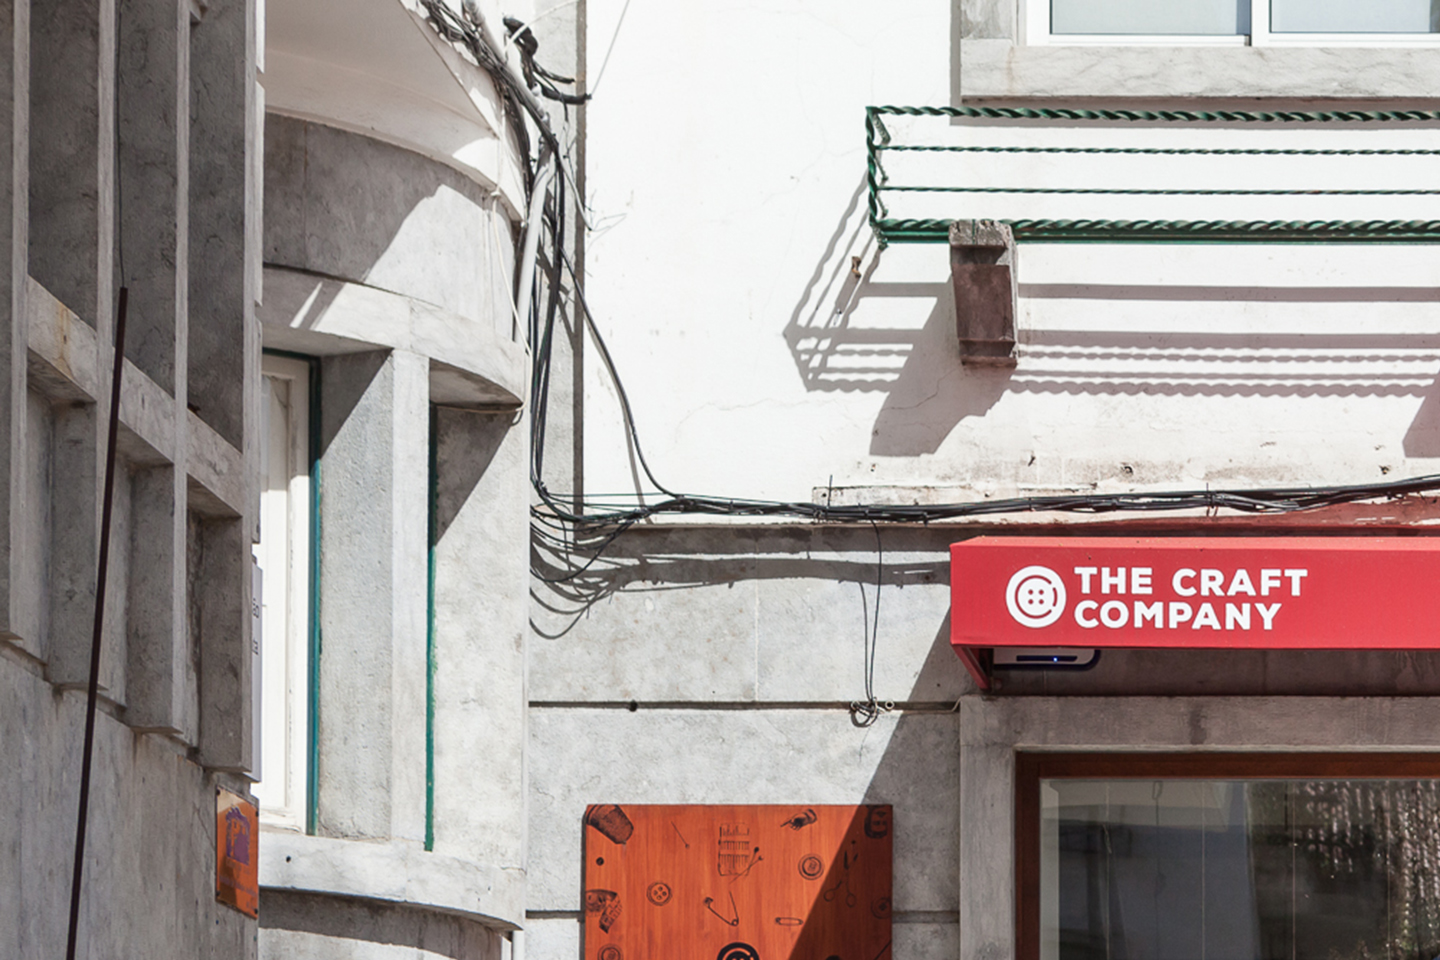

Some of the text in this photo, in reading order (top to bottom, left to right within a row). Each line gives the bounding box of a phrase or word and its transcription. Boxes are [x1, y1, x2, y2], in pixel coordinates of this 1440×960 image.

[1074, 567, 1308, 597] THE CRAFT
[1074, 600, 1282, 630] COMPANY
